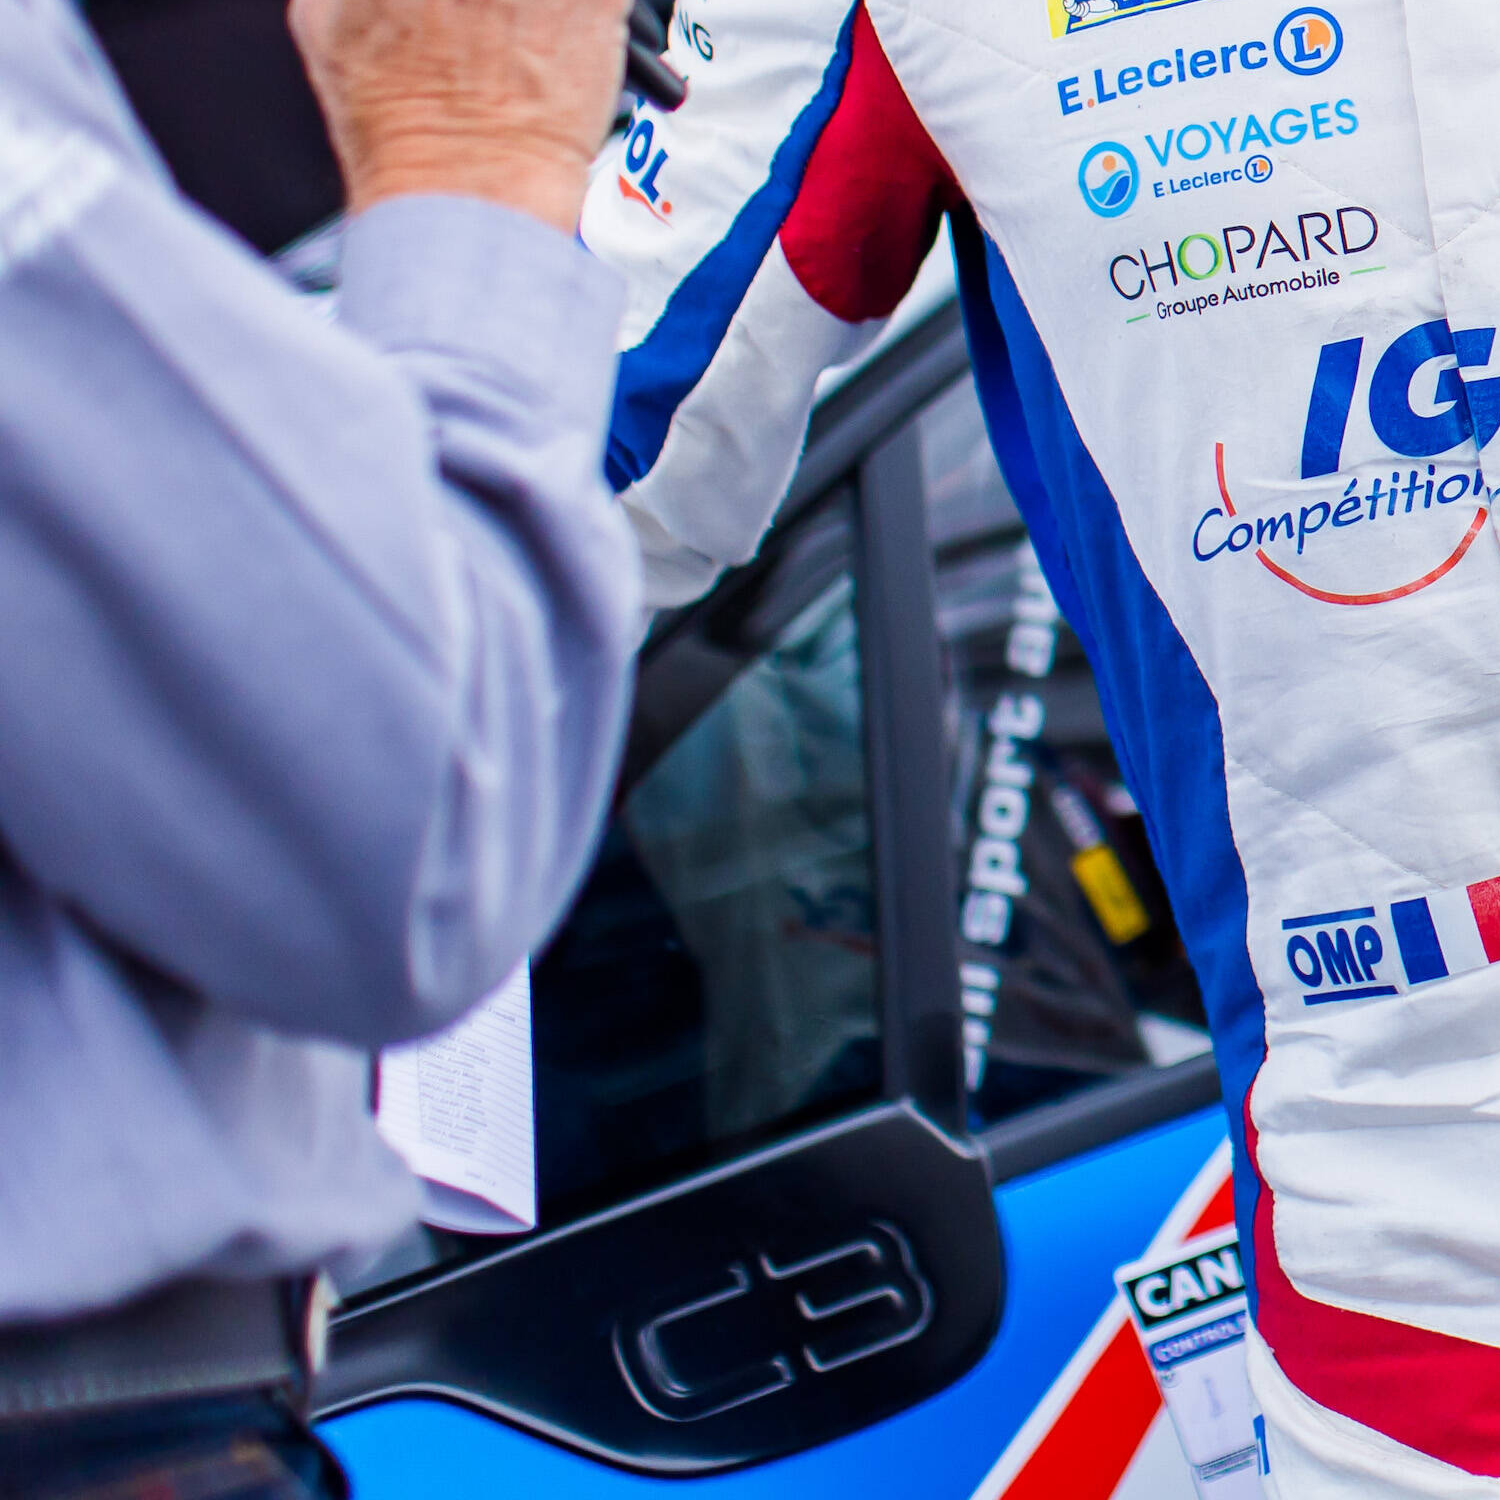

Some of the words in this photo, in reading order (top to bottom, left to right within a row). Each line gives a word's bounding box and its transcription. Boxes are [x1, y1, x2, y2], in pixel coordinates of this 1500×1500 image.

[1057, 37, 1269, 116] E.Leclerc
[1144, 98, 1360, 168] VOYAGES
[1109, 206, 1379, 301] CHOPARD
[1156, 290, 1219, 322] Groupe
[1222, 267, 1341, 306] Automobile
[962, 695, 1047, 945] sport
[1286, 921, 1384, 987] OMP
